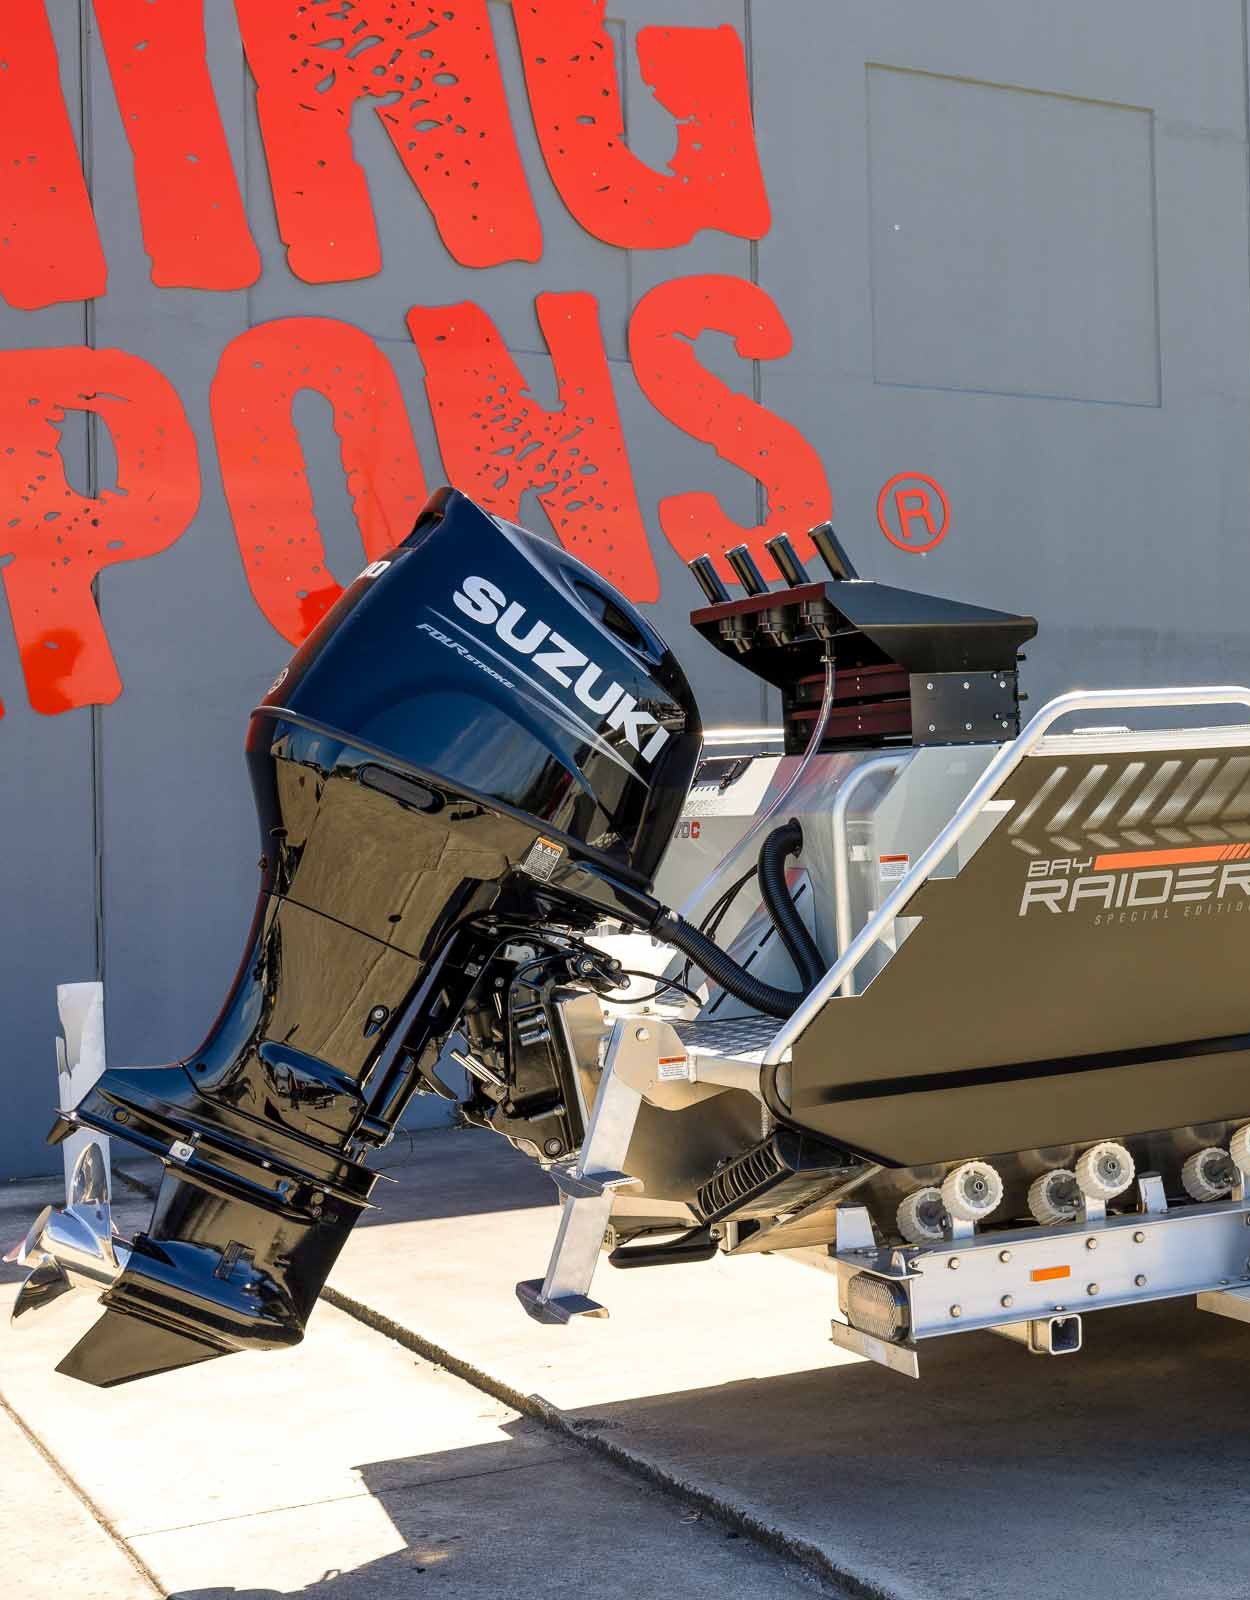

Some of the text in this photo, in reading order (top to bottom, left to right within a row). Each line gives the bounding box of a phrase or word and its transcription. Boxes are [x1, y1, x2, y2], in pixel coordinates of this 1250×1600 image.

[0, 273, 833, 719] PONS
[416, 623, 469, 656] FOUR
[452, 575, 670, 764] SUZUKI
[1027, 855, 1094, 878] BAY
[1094, 908, 1169, 926] SPECIAL
